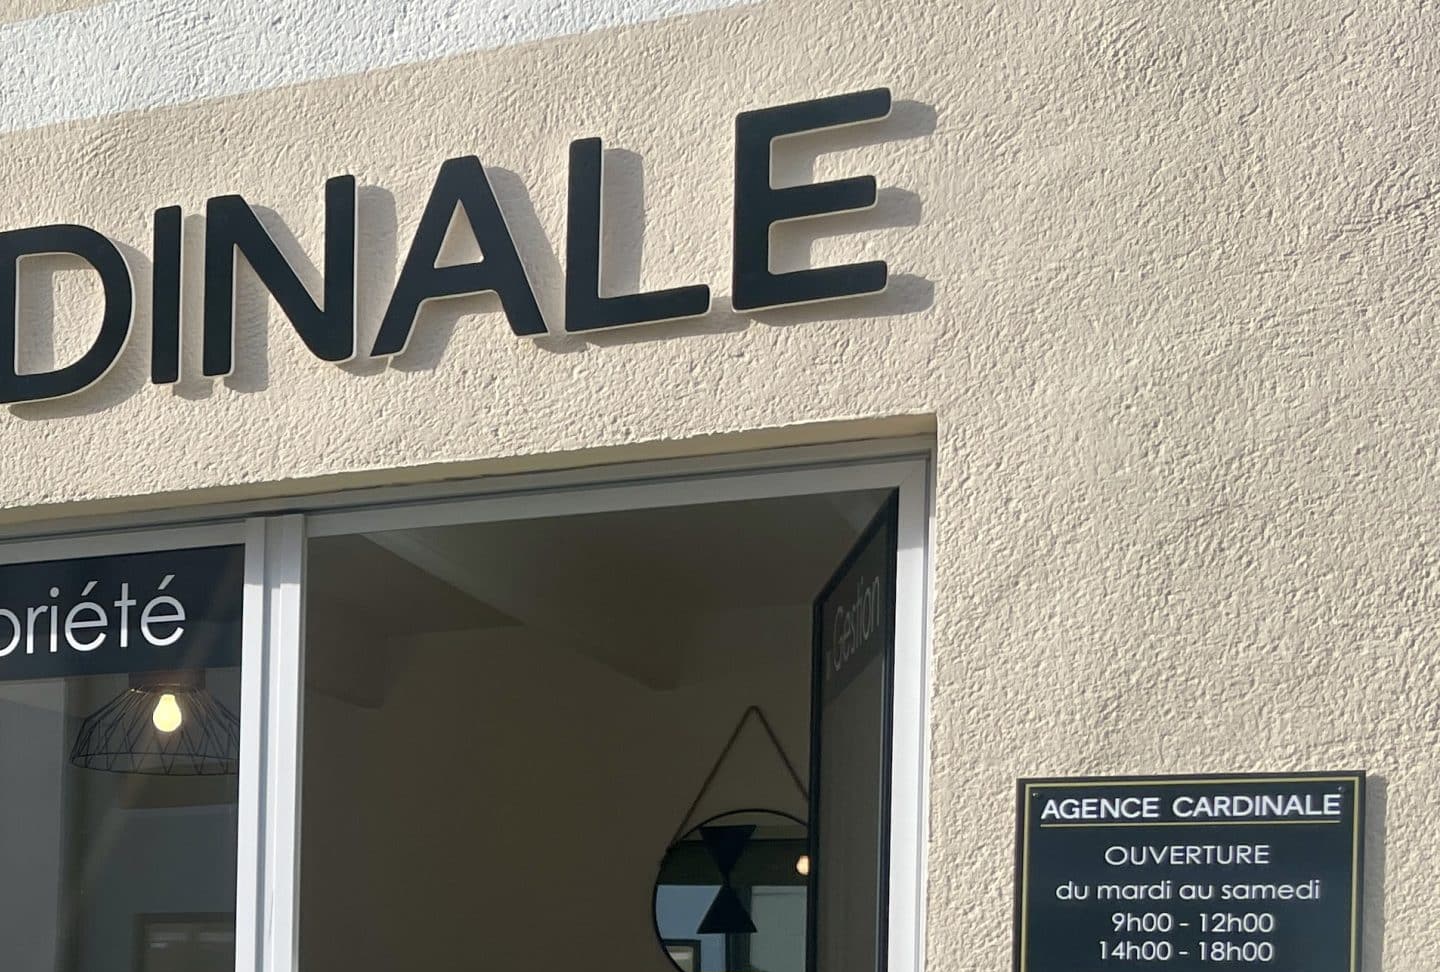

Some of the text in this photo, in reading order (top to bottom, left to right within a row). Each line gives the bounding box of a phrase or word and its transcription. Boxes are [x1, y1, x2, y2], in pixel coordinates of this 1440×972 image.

[833, 575, 881, 672] Gestion
[1040, 793, 1342, 820] AGENCE CARDINALE
[1104, 844, 1271, 866] OUVERTURE
[1055, 879, 1321, 900] du mardi au samedi
[1111, 912, 1173, 933] 9h00
[1199, 912, 1274, 933] 12h00
[1099, 940, 1172, 961] 14h00
[1198, 941, 1274, 962] 18h00
